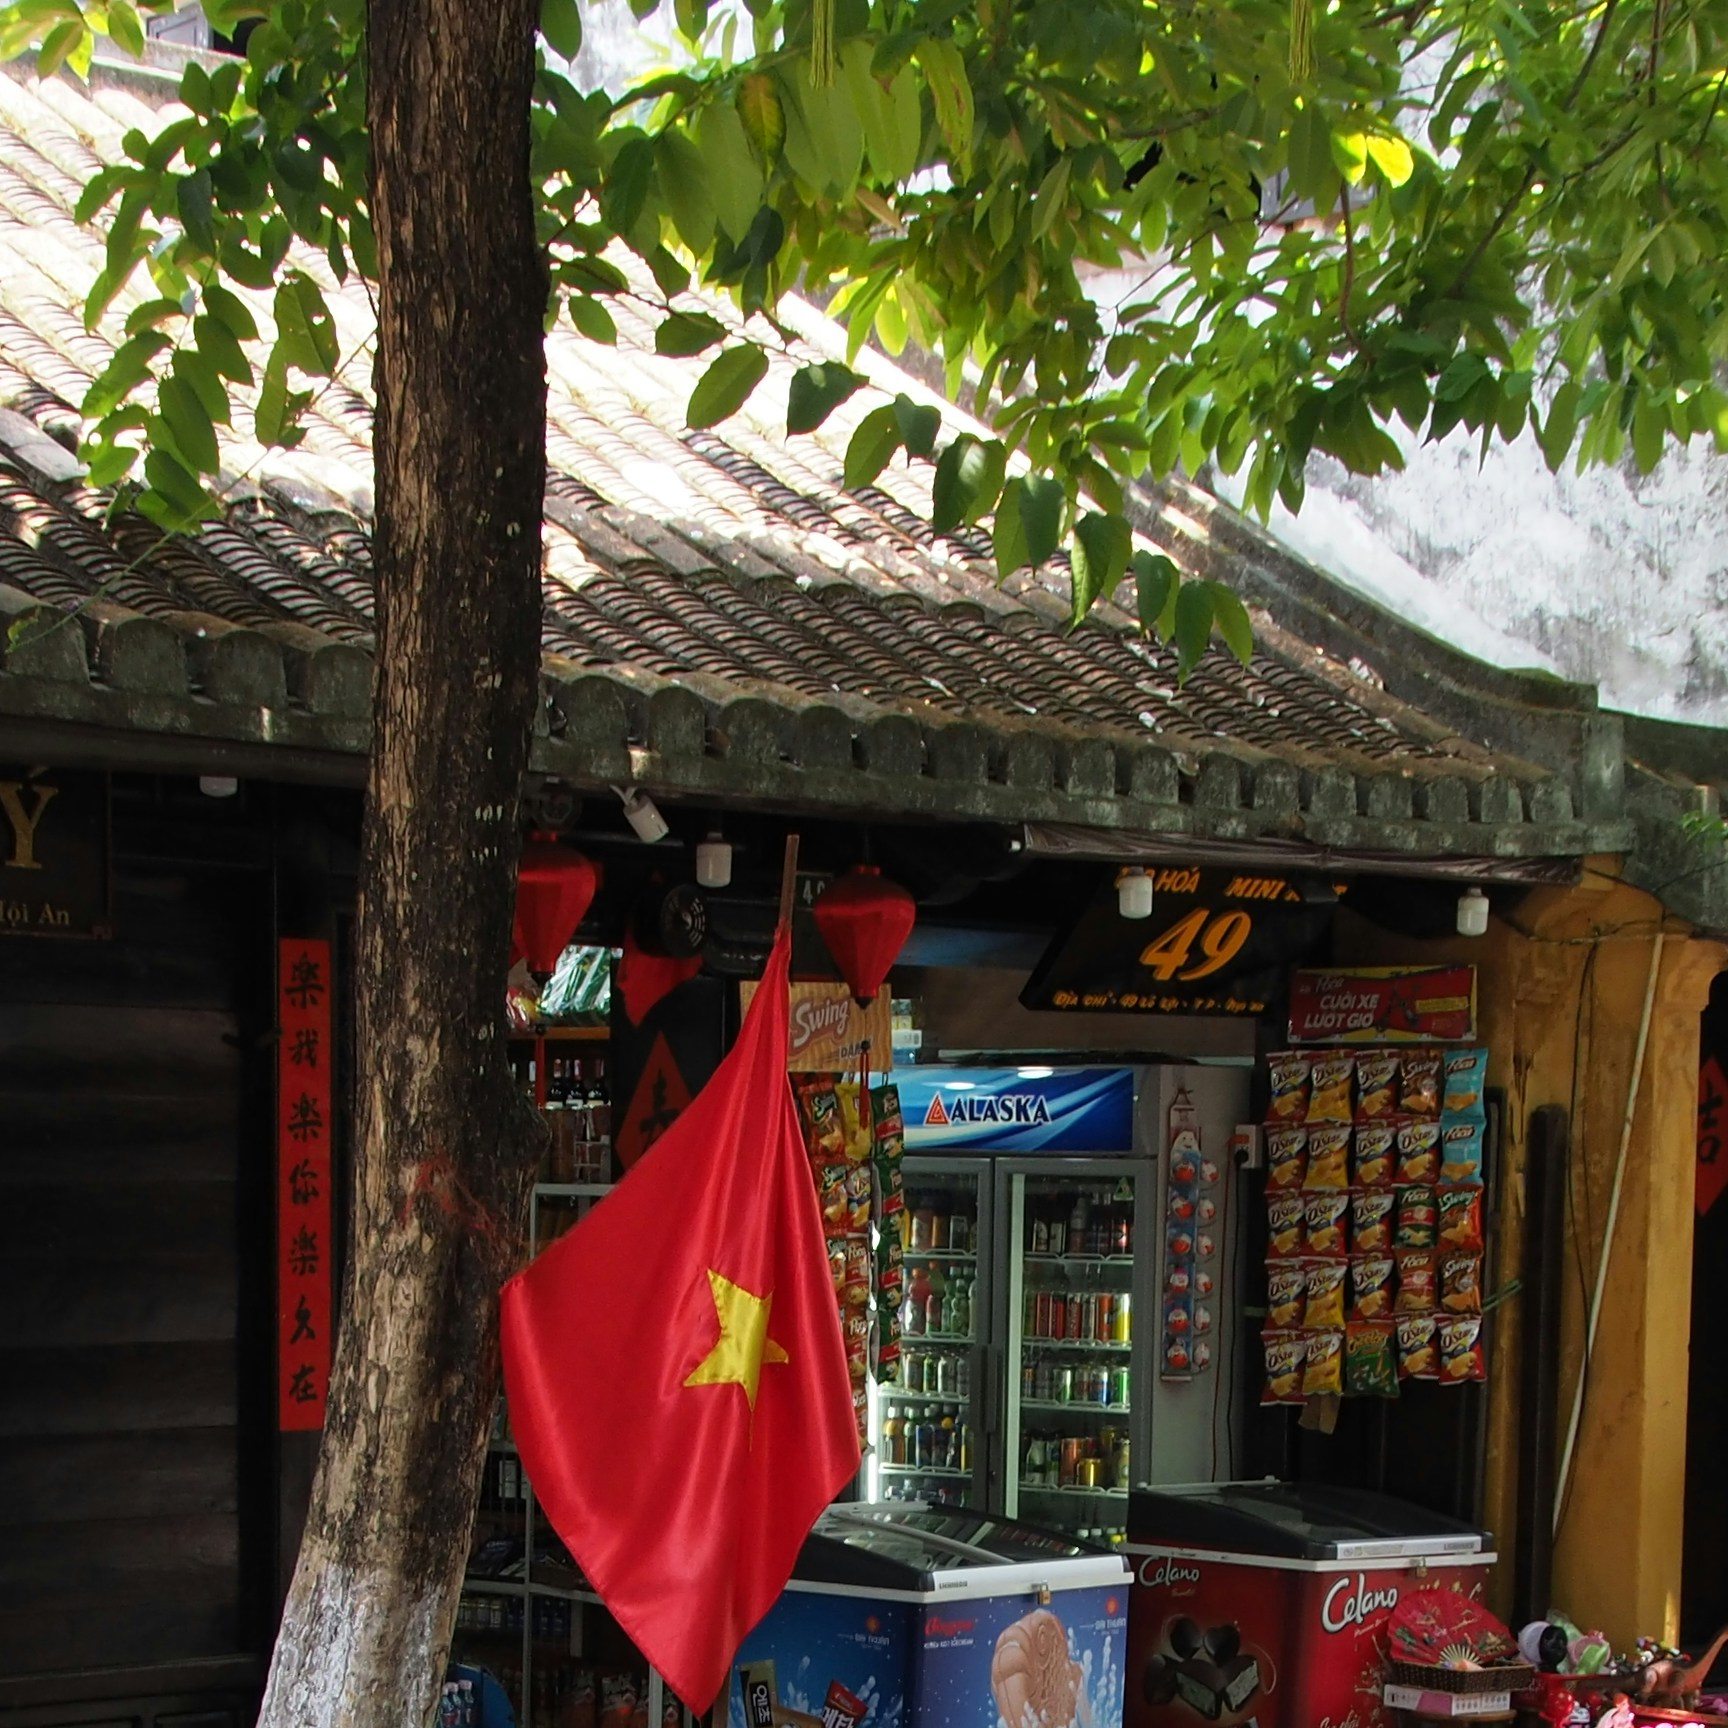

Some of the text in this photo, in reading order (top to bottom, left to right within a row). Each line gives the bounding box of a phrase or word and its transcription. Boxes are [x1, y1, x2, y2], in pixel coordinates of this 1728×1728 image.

[1225, 874, 1286, 900] MINI
[40, 902, 73, 926] An
[1138, 905, 1254, 982] 49
[793, 998, 850, 1048] Swing
[950, 1095, 1050, 1124] ALASKA
[1138, 1554, 1201, 1588] Celano
[1322, 1572, 1398, 1634] Celano
